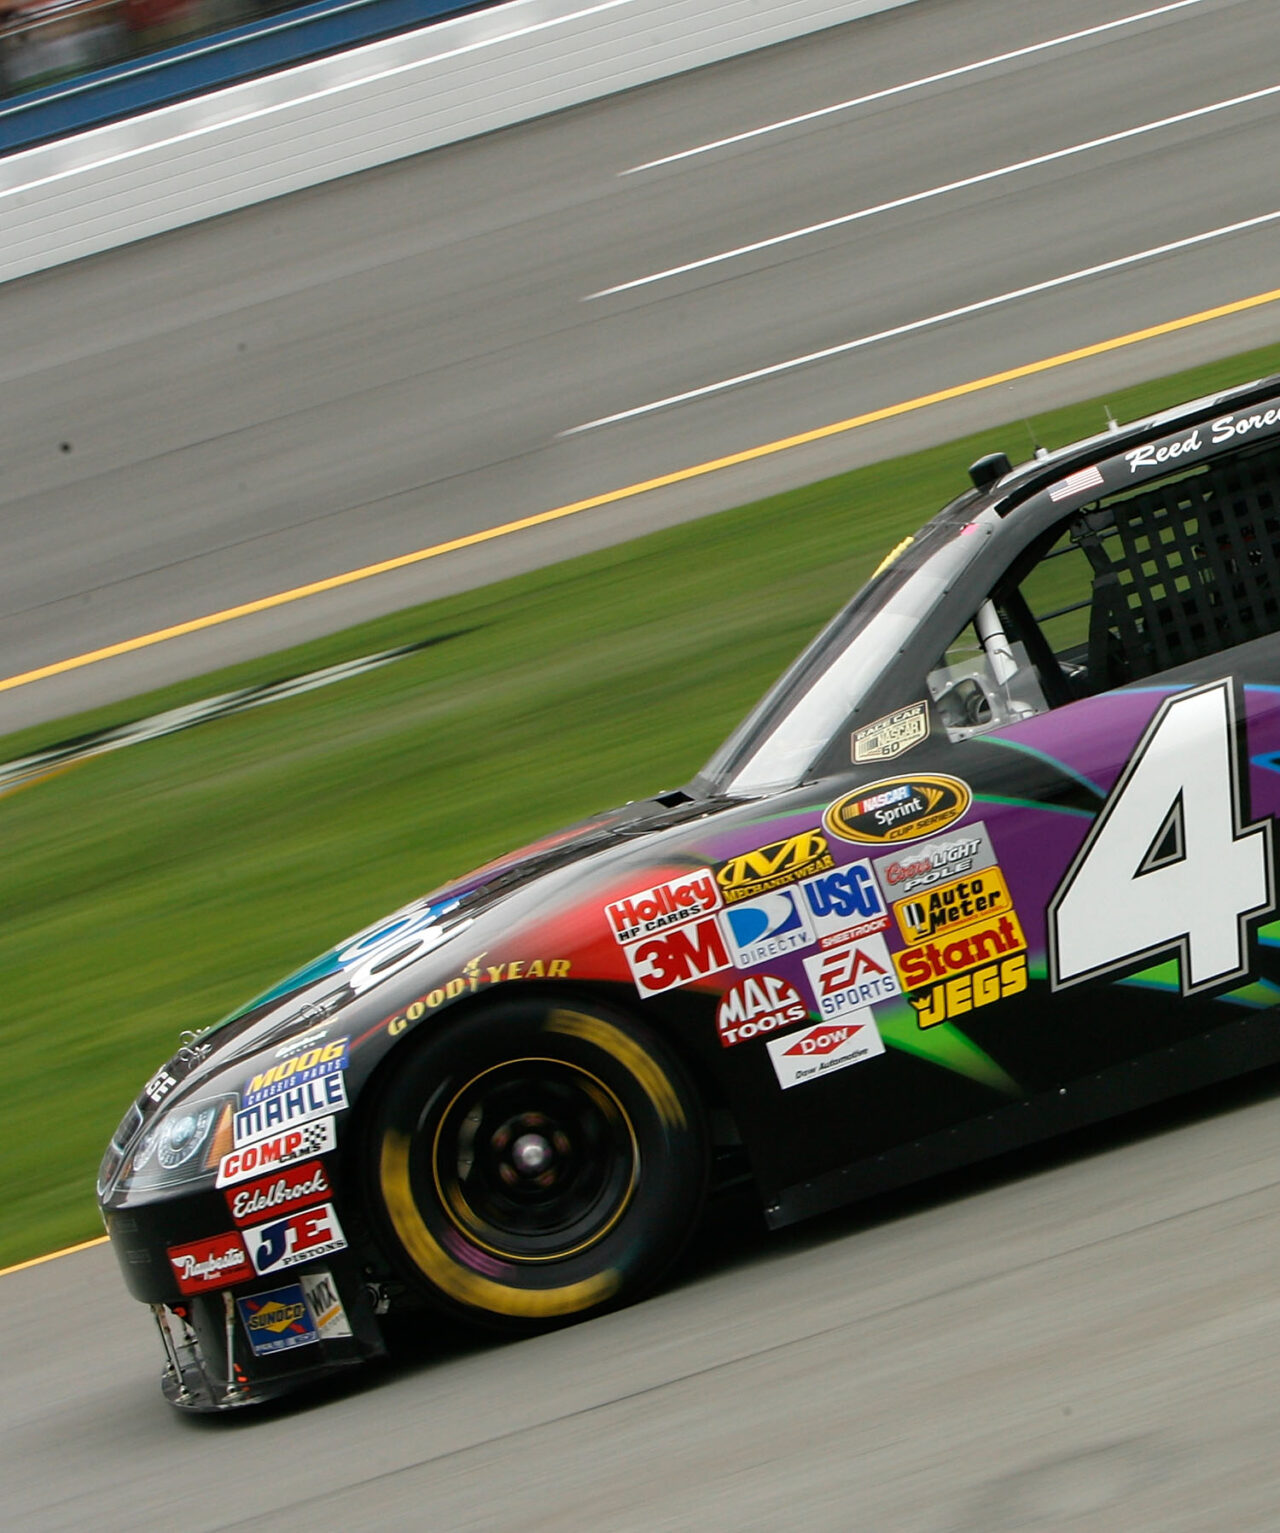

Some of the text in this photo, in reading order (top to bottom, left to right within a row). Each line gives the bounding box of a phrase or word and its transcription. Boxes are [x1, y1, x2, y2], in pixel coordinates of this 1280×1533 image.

[1125, 429, 1203, 473] Reed
[864, 784, 912, 814] NASCAR
[875, 798, 923, 826] Sprint
[889, 808, 957, 840] CUP SERIES
[884, 837, 982, 886] Coors LIGHT
[904, 859, 972, 894] POLE
[610, 871, 718, 933] Holley
[804, 863, 876, 919] USG
[924, 888, 1002, 934] Meter
[928, 880, 983, 911] Auto
[619, 904, 702, 942] HP CARBS
[821, 919, 887, 948] SHEETROCK
[634, 920, 731, 991] 3M
[741, 932, 808, 966] DIRECTV
[819, 947, 888, 996] EA
[899, 919, 1020, 987] Stant
[719, 977, 800, 1031] MAC
[822, 975, 896, 1014] SPORTS
[918, 953, 1028, 1030] JEGS
[722, 1005, 808, 1043] TOOLS
[247, 1059, 343, 1106] CHASSIS PARTS
[237, 1073, 344, 1141] MAHLE
[223, 1131, 302, 1178] COMP
[279, 1143, 322, 1163] CAMS
[233, 1169, 329, 1219] Edelbrock
[255, 1206, 333, 1271] JE
[282, 1240, 345, 1266] PISTONS
[250, 1303, 305, 1330] SUNOCO
